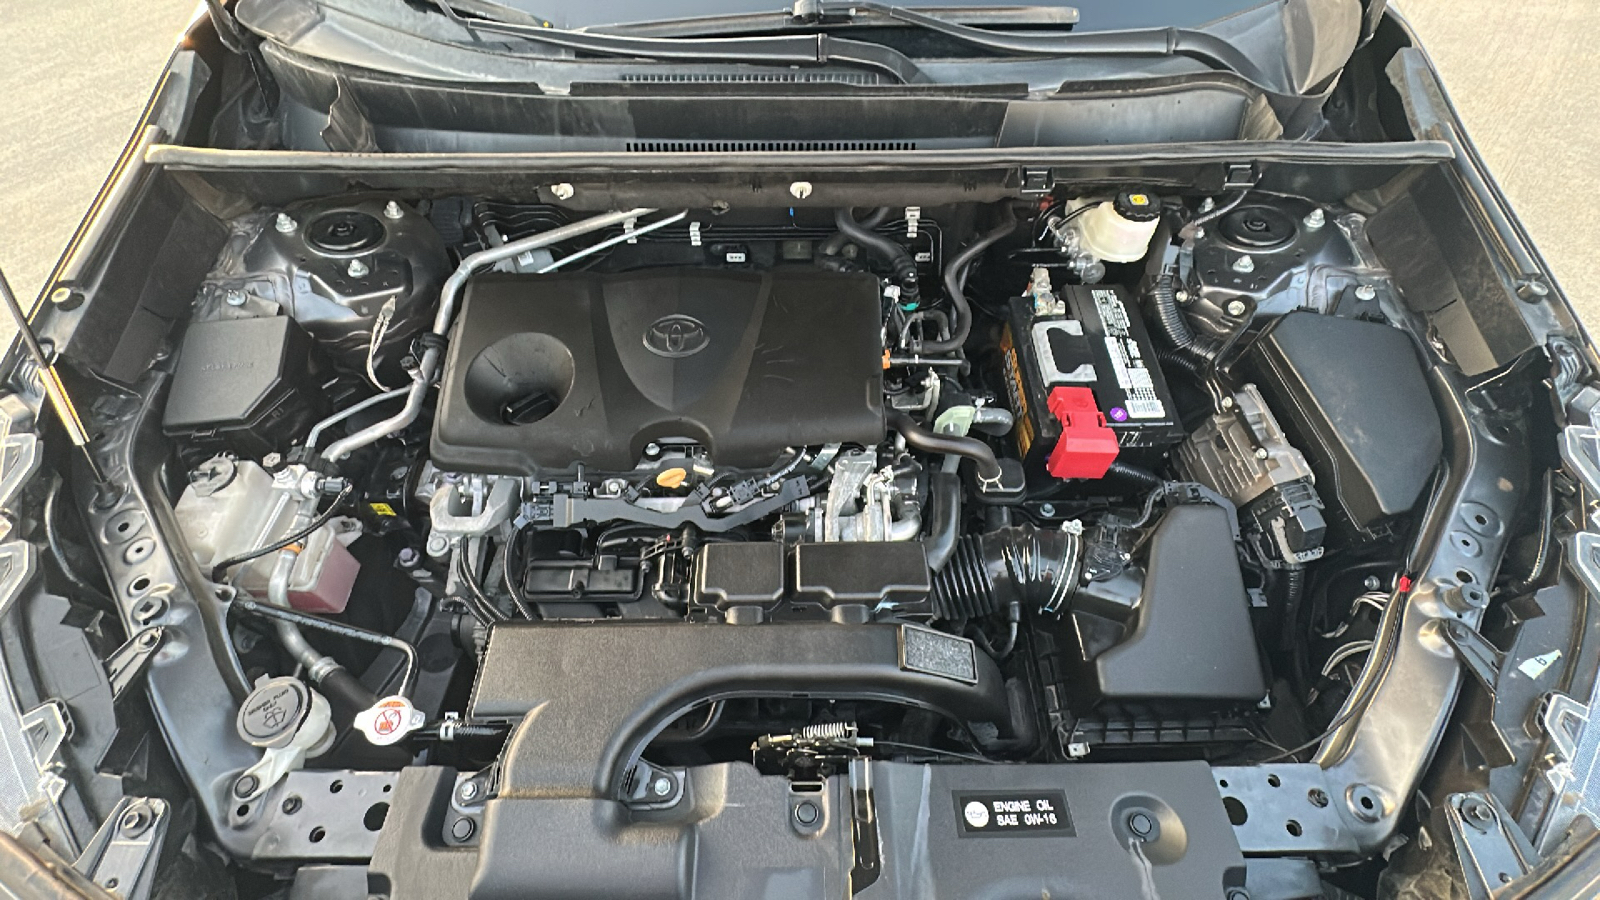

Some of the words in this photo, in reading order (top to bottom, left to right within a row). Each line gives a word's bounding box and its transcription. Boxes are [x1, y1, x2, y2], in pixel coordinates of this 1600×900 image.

[993, 800, 1031, 812] ENGINE
[1036, 800, 1054, 811] OIL
[996, 814, 1019, 826] SAE
